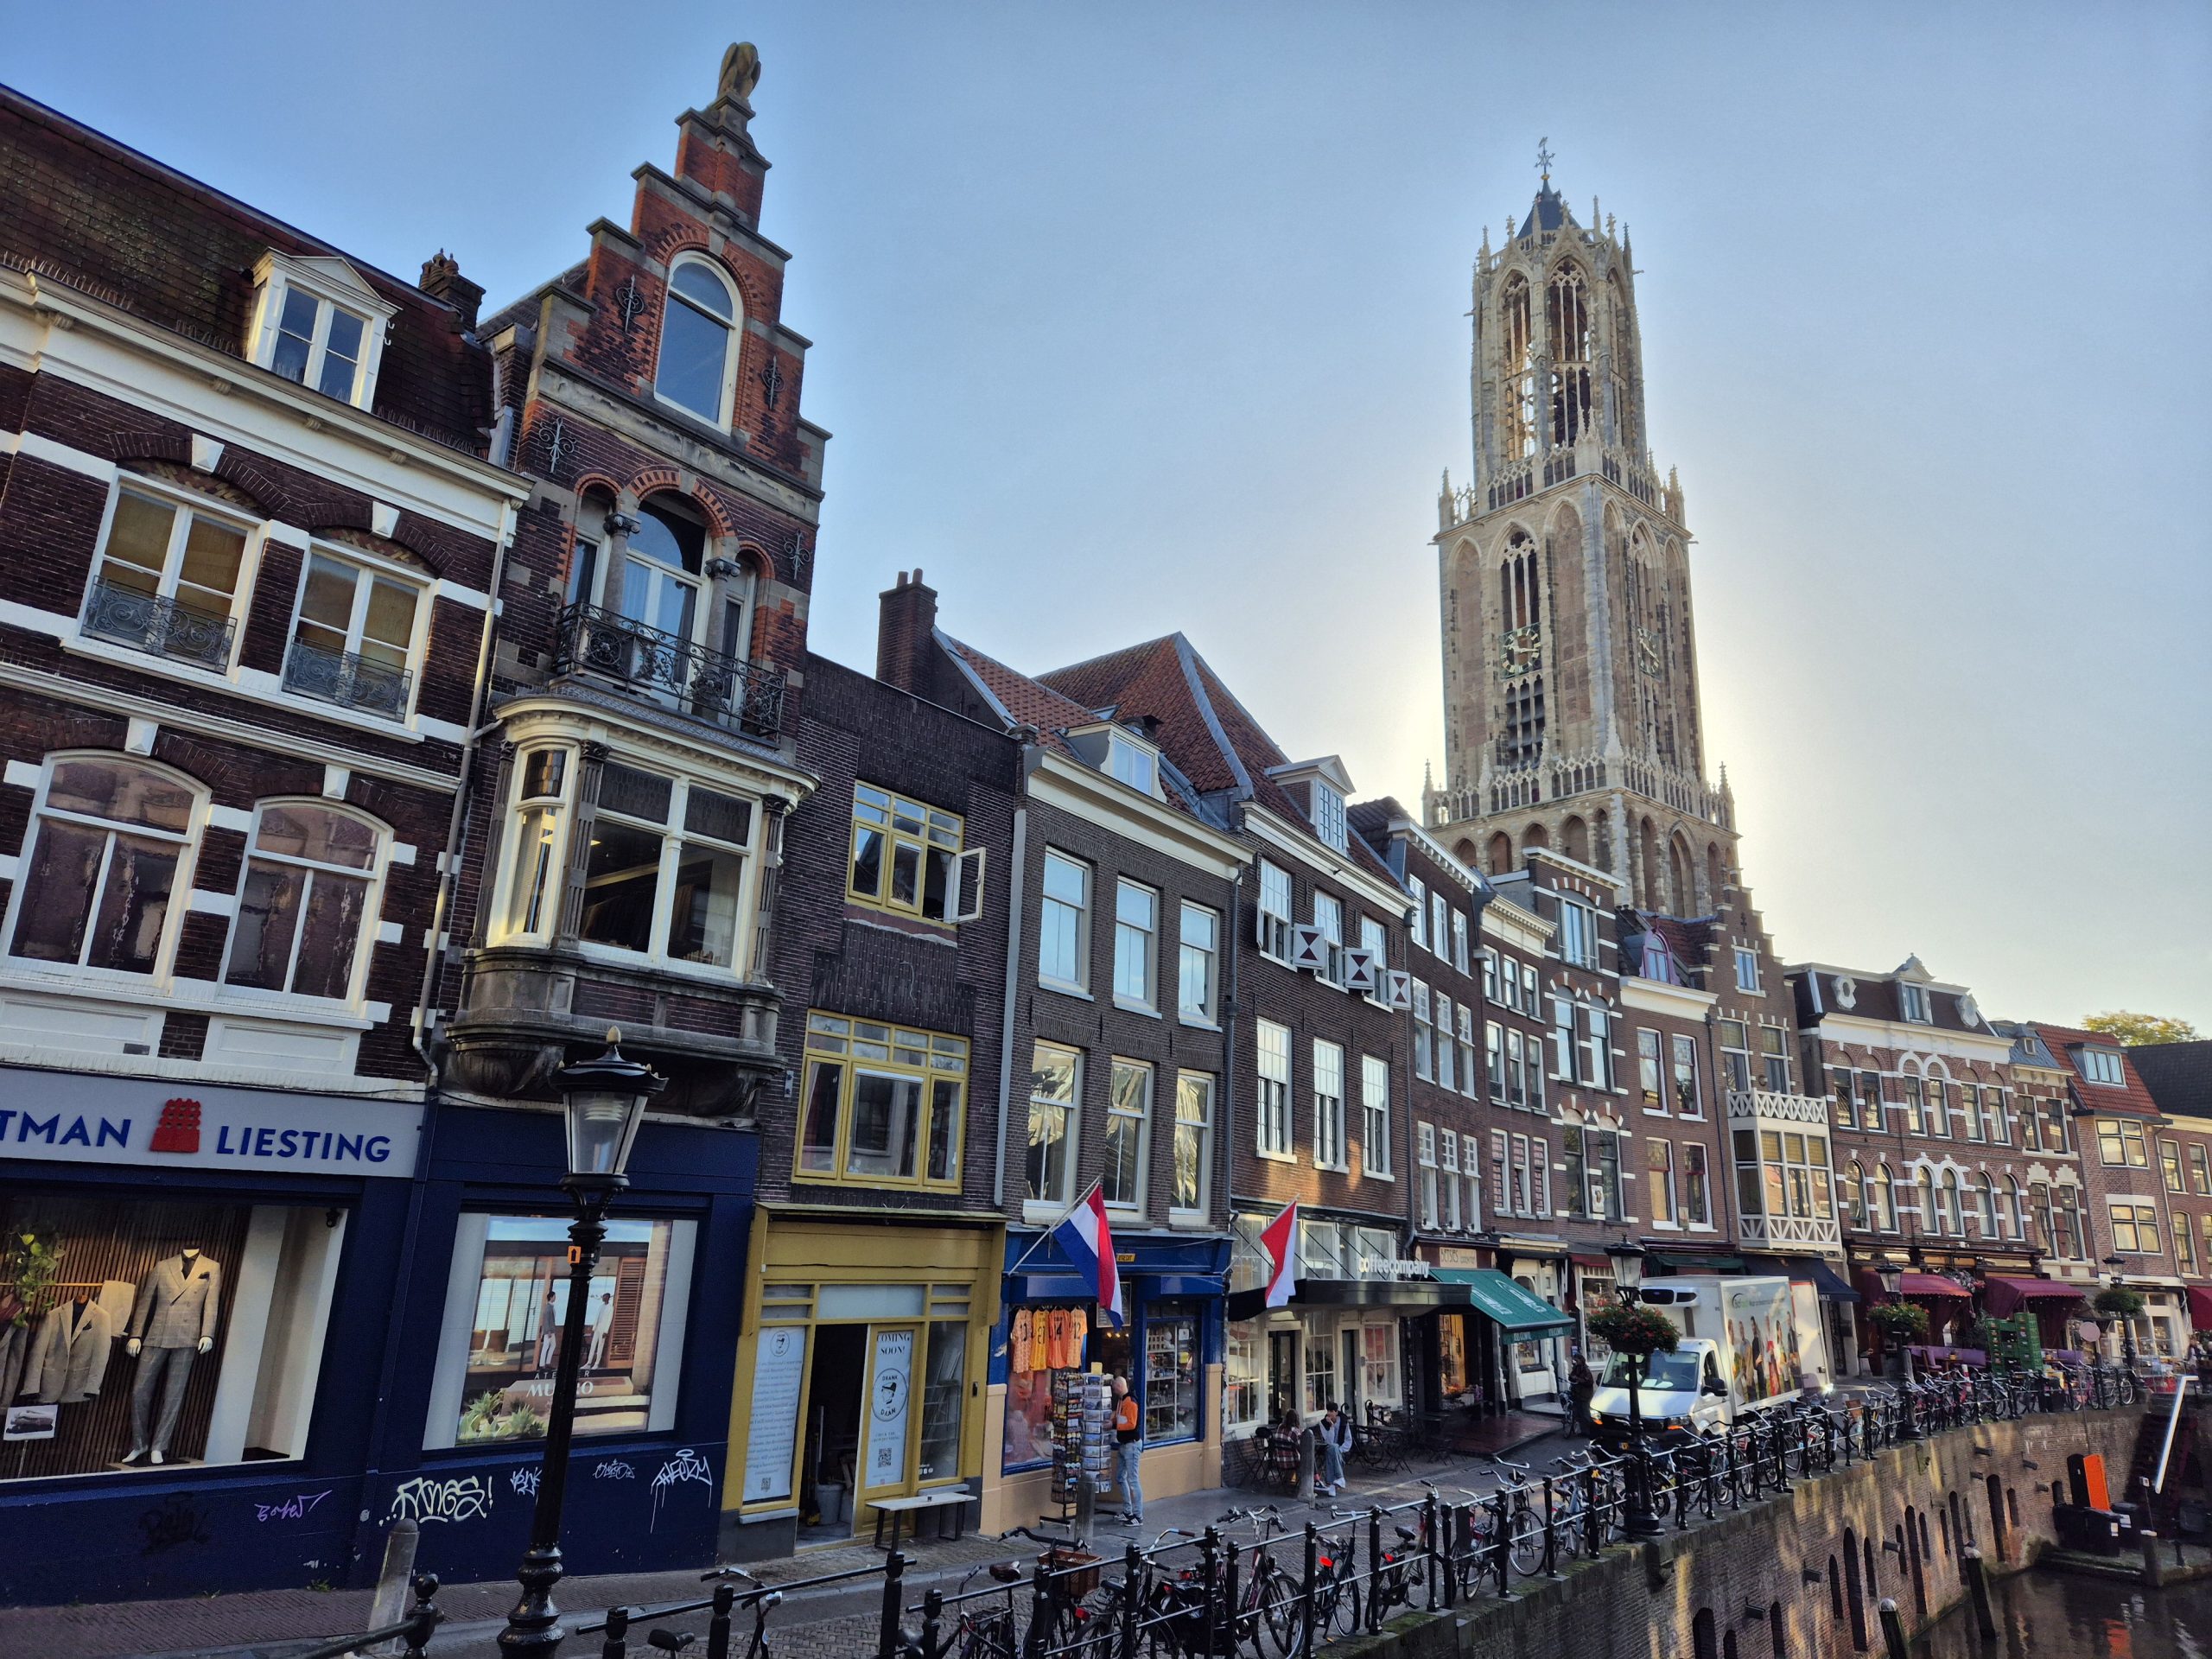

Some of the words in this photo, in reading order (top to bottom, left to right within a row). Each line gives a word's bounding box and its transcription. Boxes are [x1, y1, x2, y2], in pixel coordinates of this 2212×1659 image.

[216, 1126, 391, 1163] LIESTING
[1357, 1254, 1429, 1278] coffeecompany
[876, 1332, 910, 1342] COMING
[880, 1345, 906, 1355] SOON!
